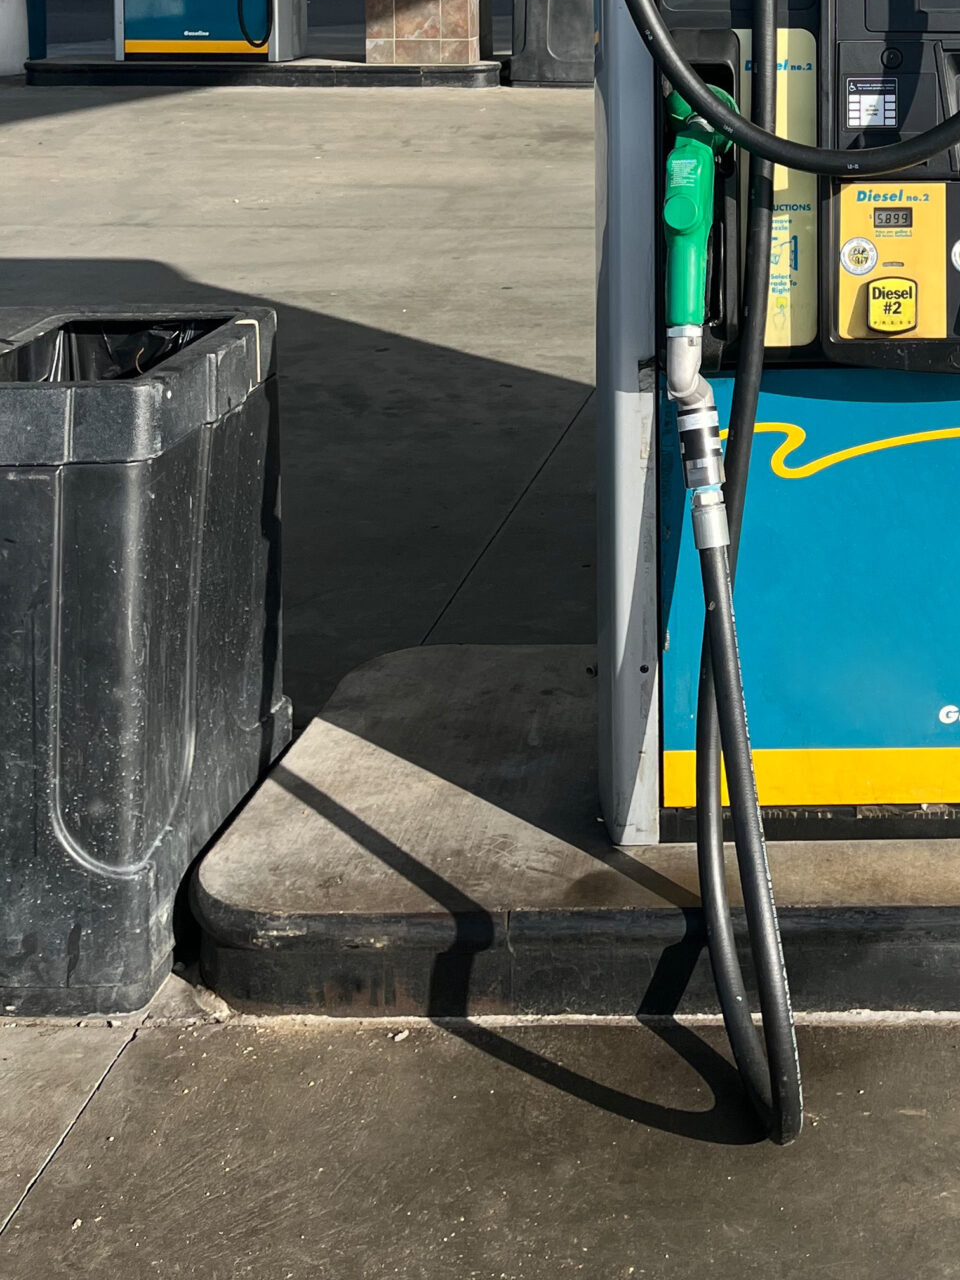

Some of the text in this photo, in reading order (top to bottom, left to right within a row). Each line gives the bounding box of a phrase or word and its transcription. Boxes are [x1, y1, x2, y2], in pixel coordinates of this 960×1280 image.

[856, 189, 930, 202] Diesel no.2
[773, 203, 811, 211] UCTIONS
[872, 286, 912, 300] Diesel
[883, 301, 902, 315] #2
